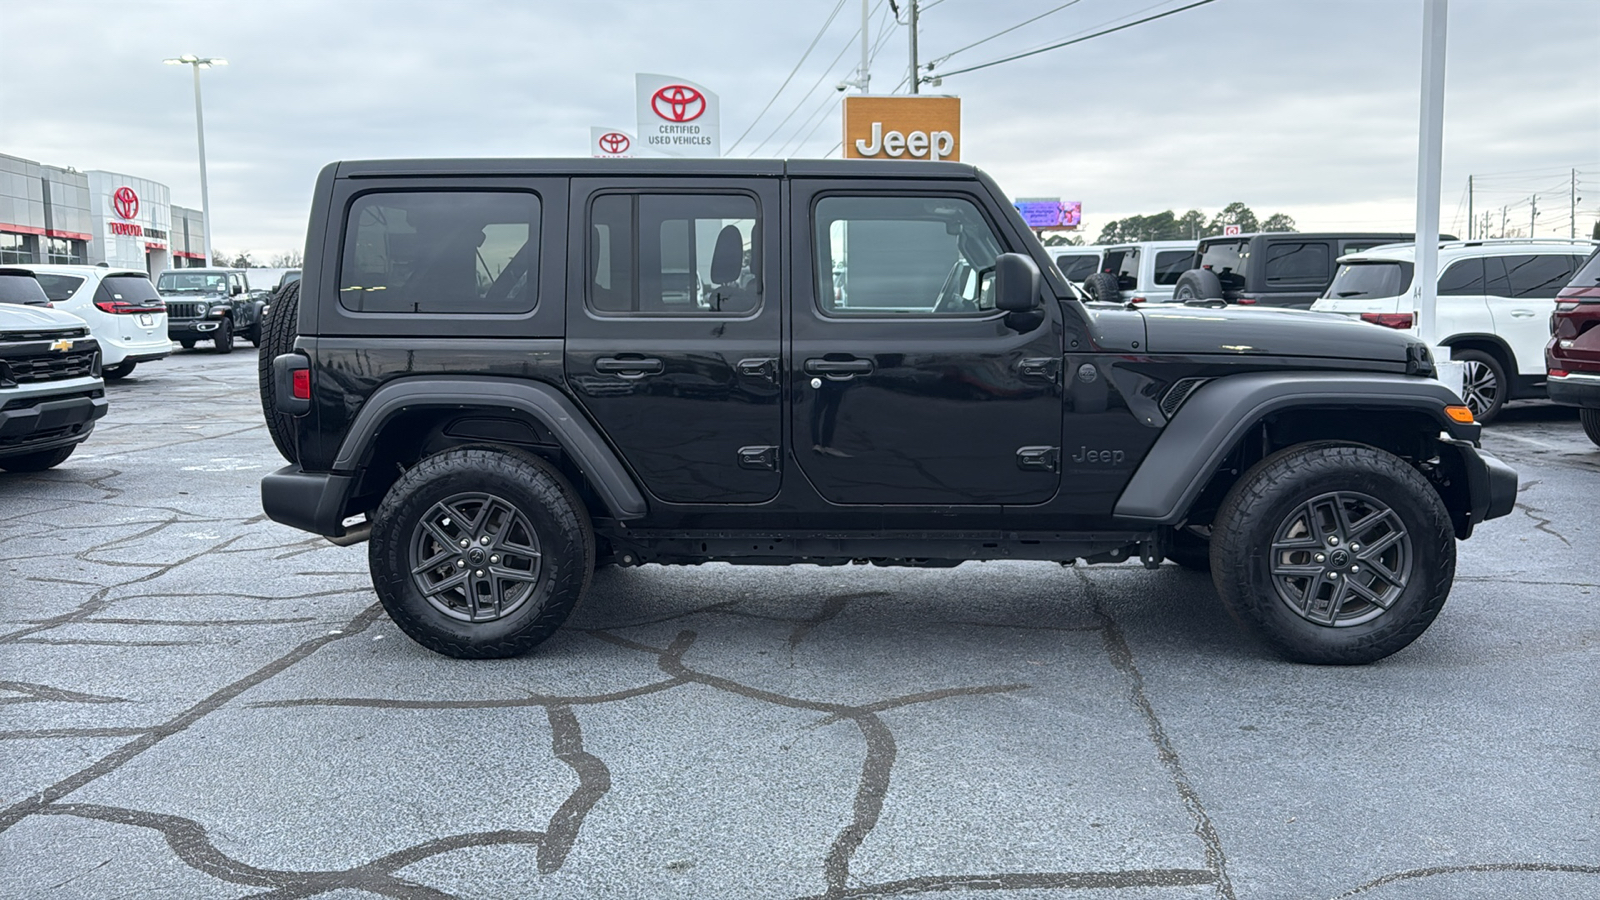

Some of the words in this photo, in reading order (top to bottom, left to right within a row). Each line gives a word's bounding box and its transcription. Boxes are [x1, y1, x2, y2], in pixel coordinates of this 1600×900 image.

[659, 125, 700, 134] CERTIFIED
[648, 136, 671, 145] USED
[673, 136, 711, 146] VEHICLES
[856, 122, 954, 160] Jeep
[110, 222, 144, 237] TOYOTA
[1072, 445, 1125, 466] Jeep
